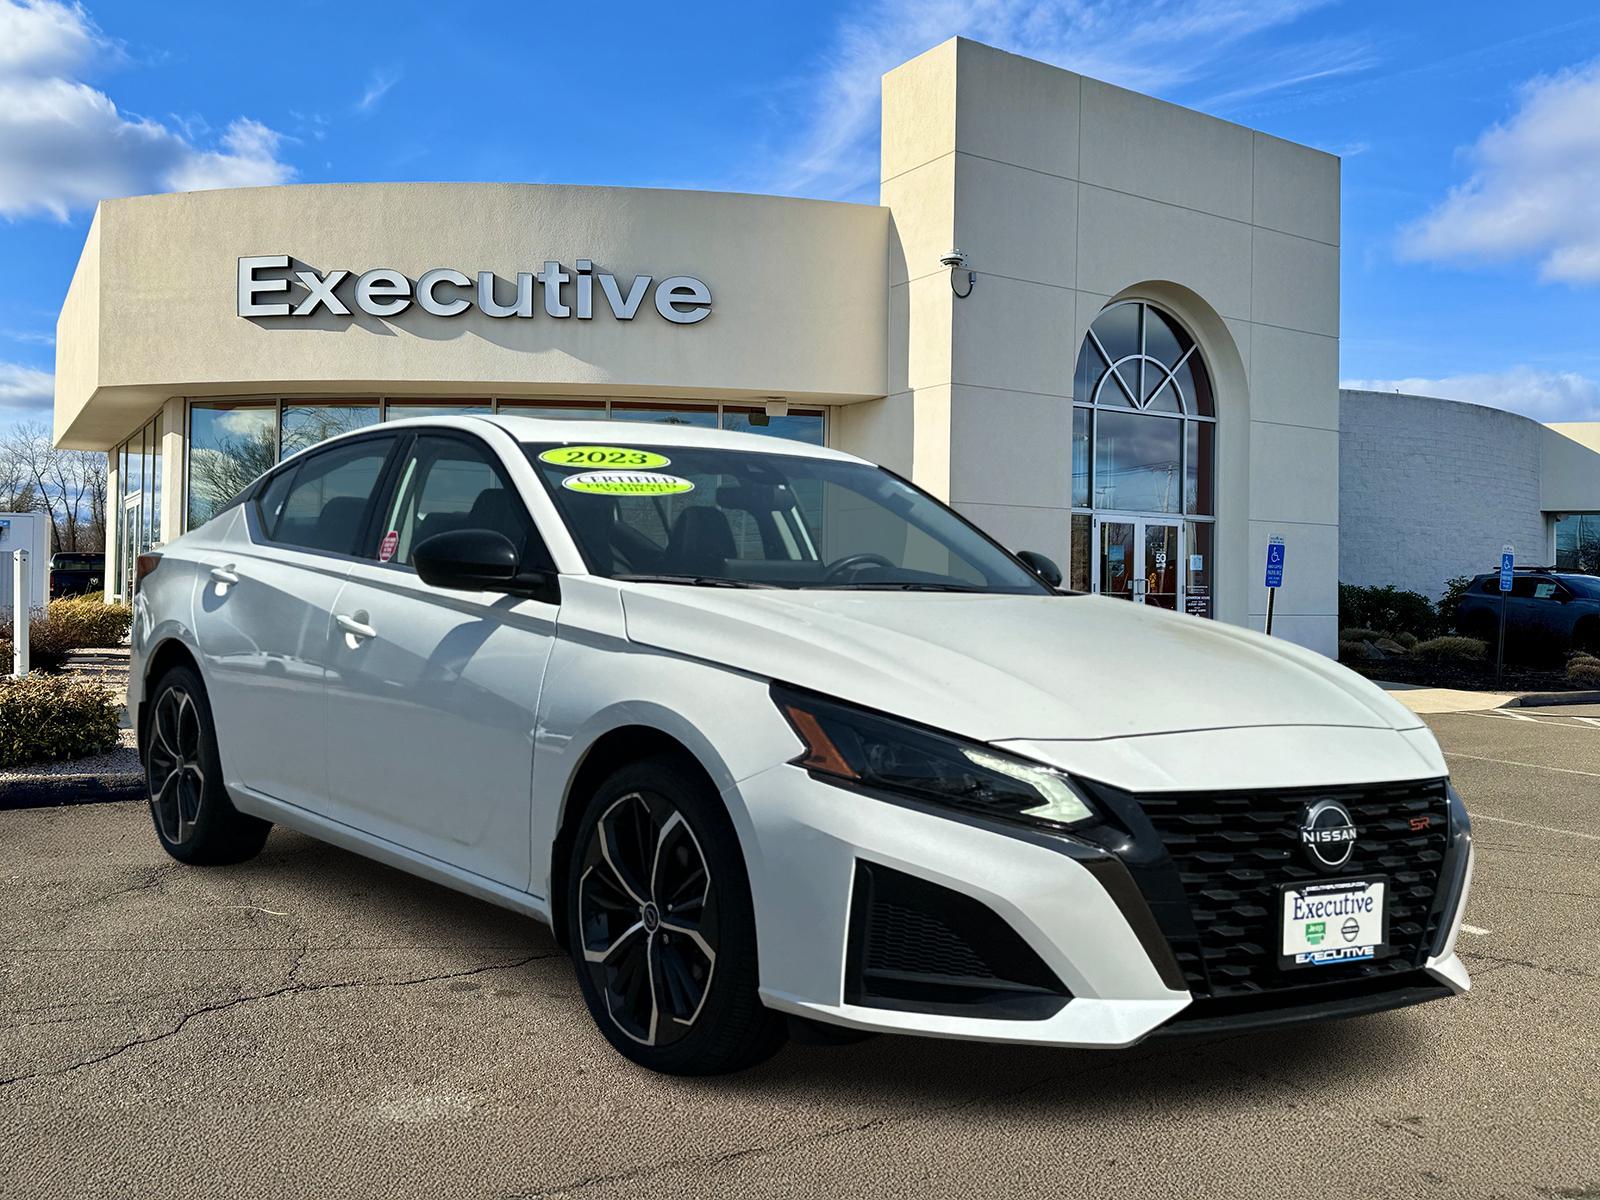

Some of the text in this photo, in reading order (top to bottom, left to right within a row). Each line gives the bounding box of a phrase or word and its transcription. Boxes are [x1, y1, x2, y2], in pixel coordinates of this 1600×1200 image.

[238, 255, 713, 325] Executive
[566, 451, 648, 464] 2023
[577, 476, 677, 484] CERTIFIED
[1409, 816, 1430, 831] SR
[1302, 828, 1357, 842] NISSAN
[1293, 892, 1373, 920] Executive
[1295, 946, 1375, 964] EXECUTIVE
